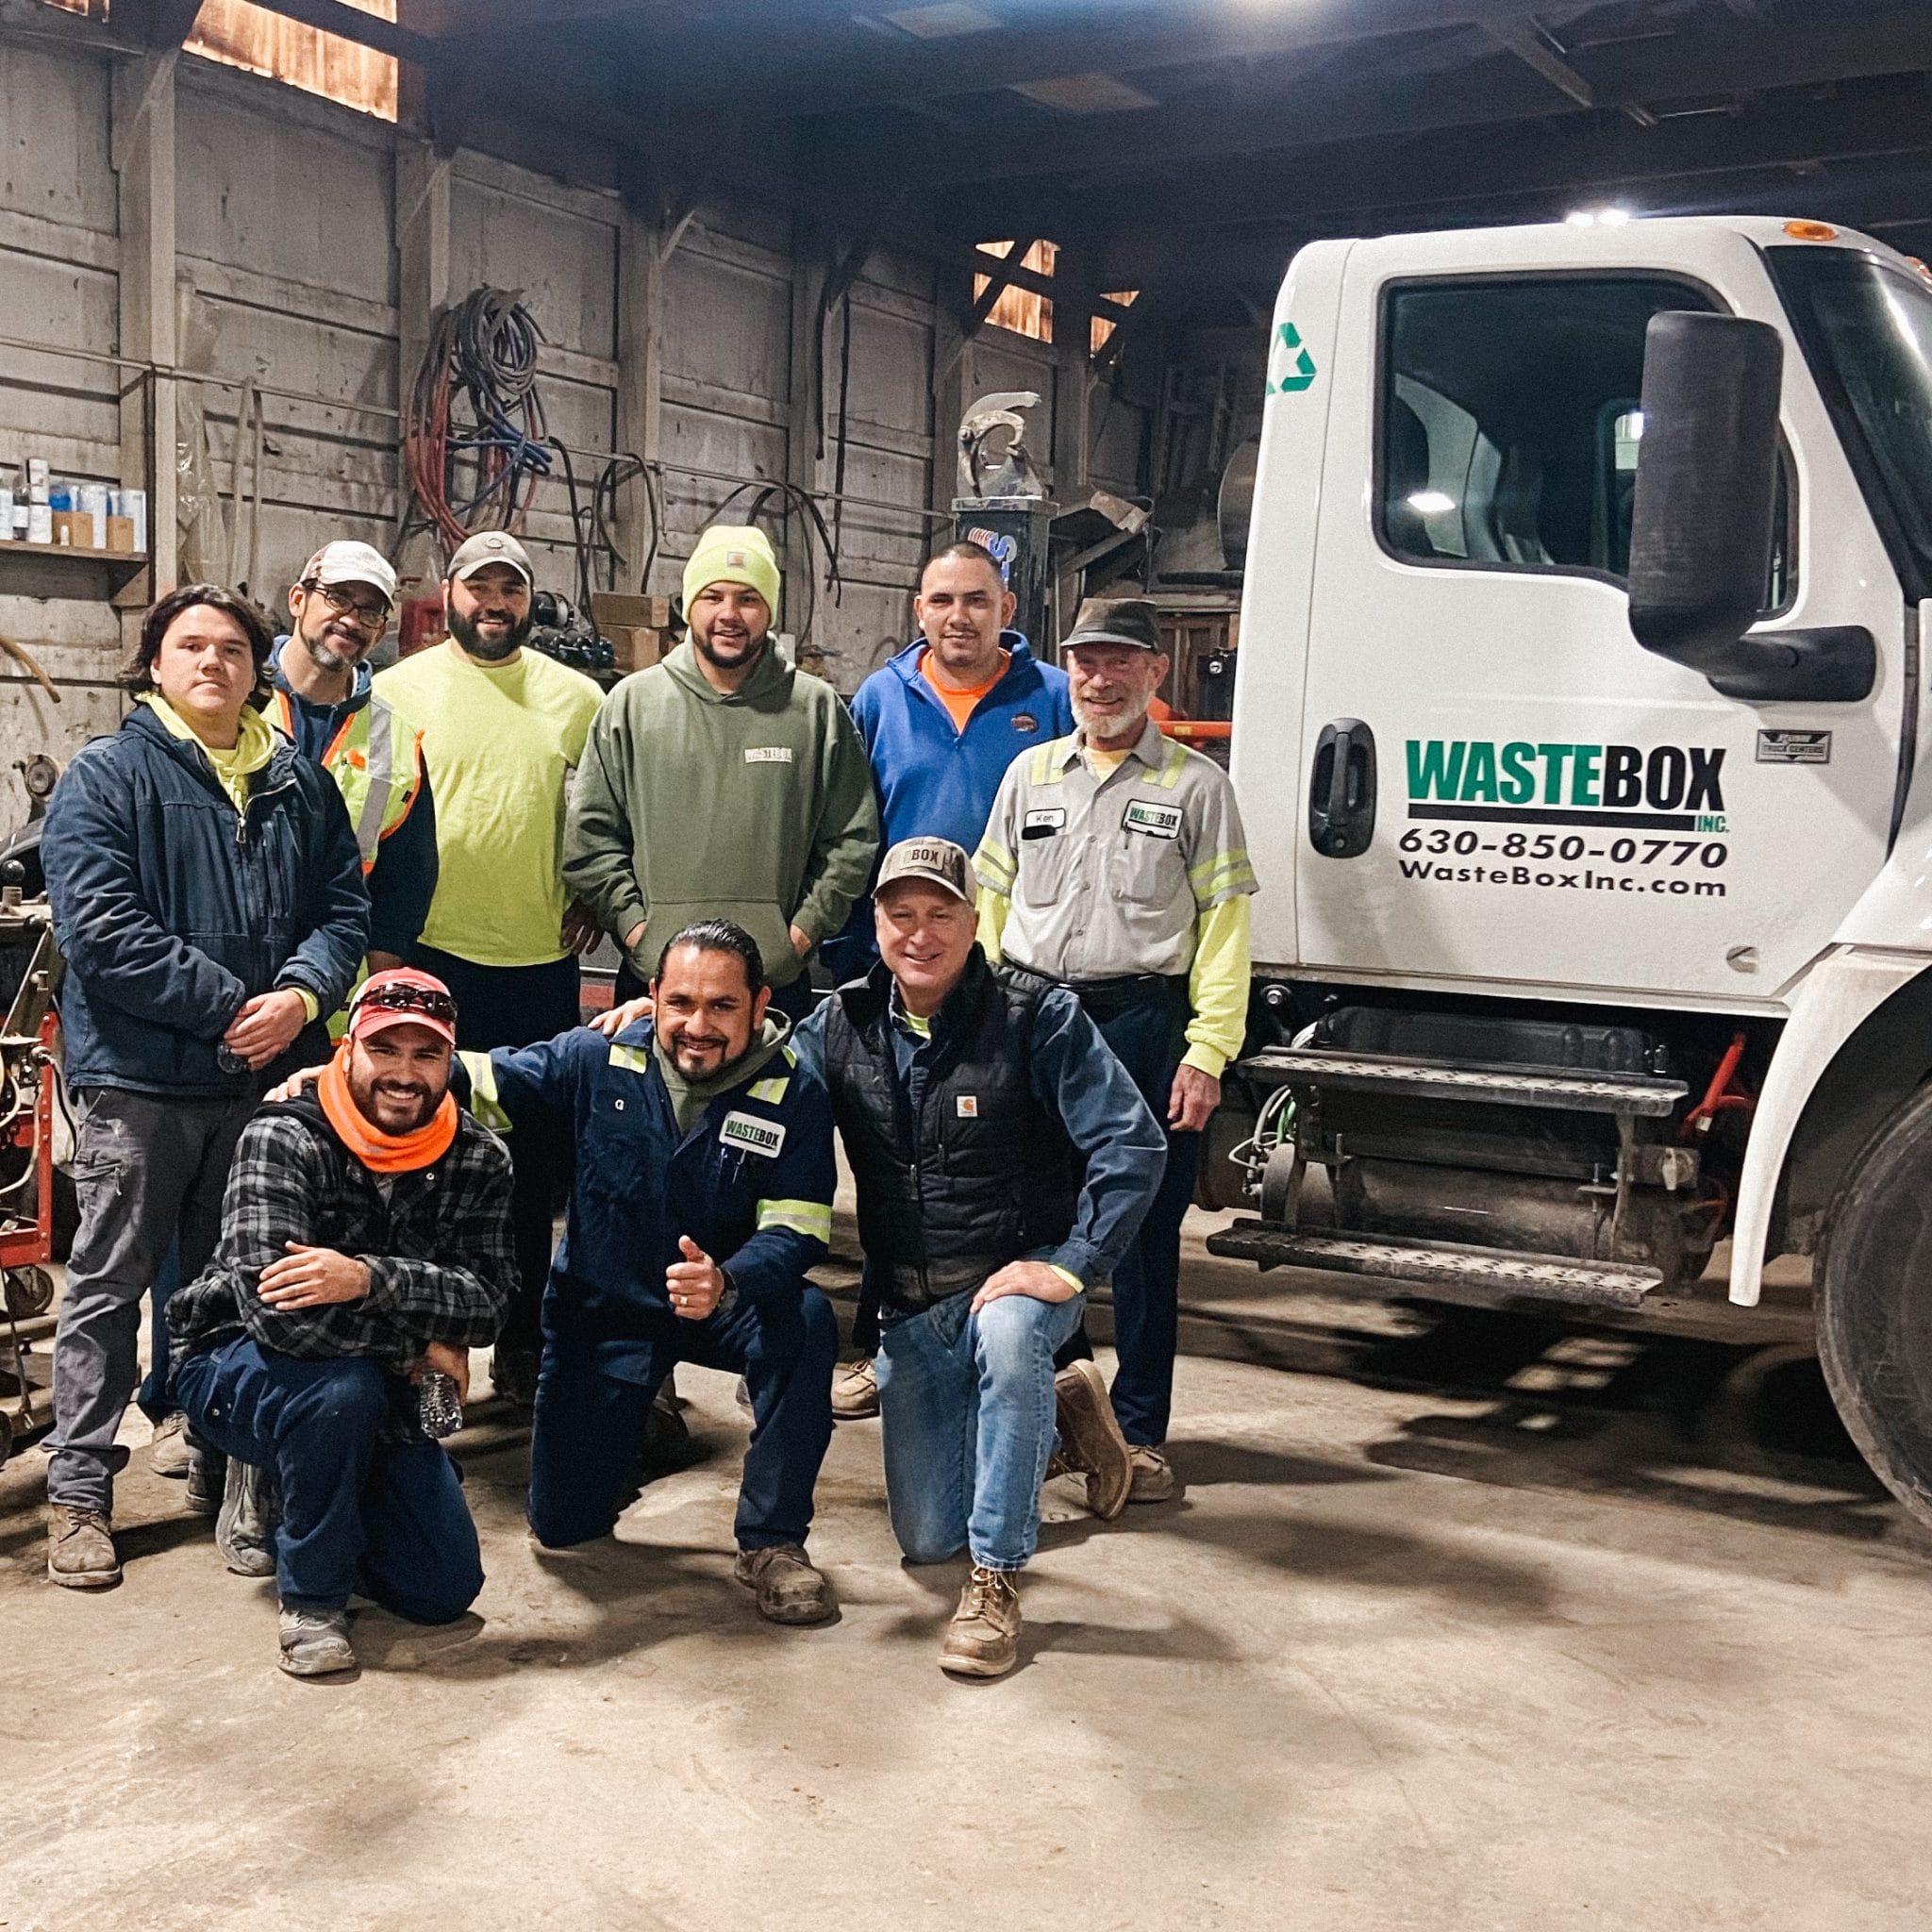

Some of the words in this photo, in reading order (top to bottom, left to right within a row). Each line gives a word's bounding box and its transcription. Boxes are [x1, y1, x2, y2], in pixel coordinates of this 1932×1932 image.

[1406, 740, 1727, 812] WASTEBOX
[1036, 814, 1054, 824] Ken
[1130, 807, 1178, 826] WASTEBOX
[1696, 815, 1729, 833] INC.
[1399, 828, 1728, 868] 630-850-0770
[1399, 859, 1726, 896] WasteBoxInc.com
[725, 1120, 780, 1147] WASTEBOX
